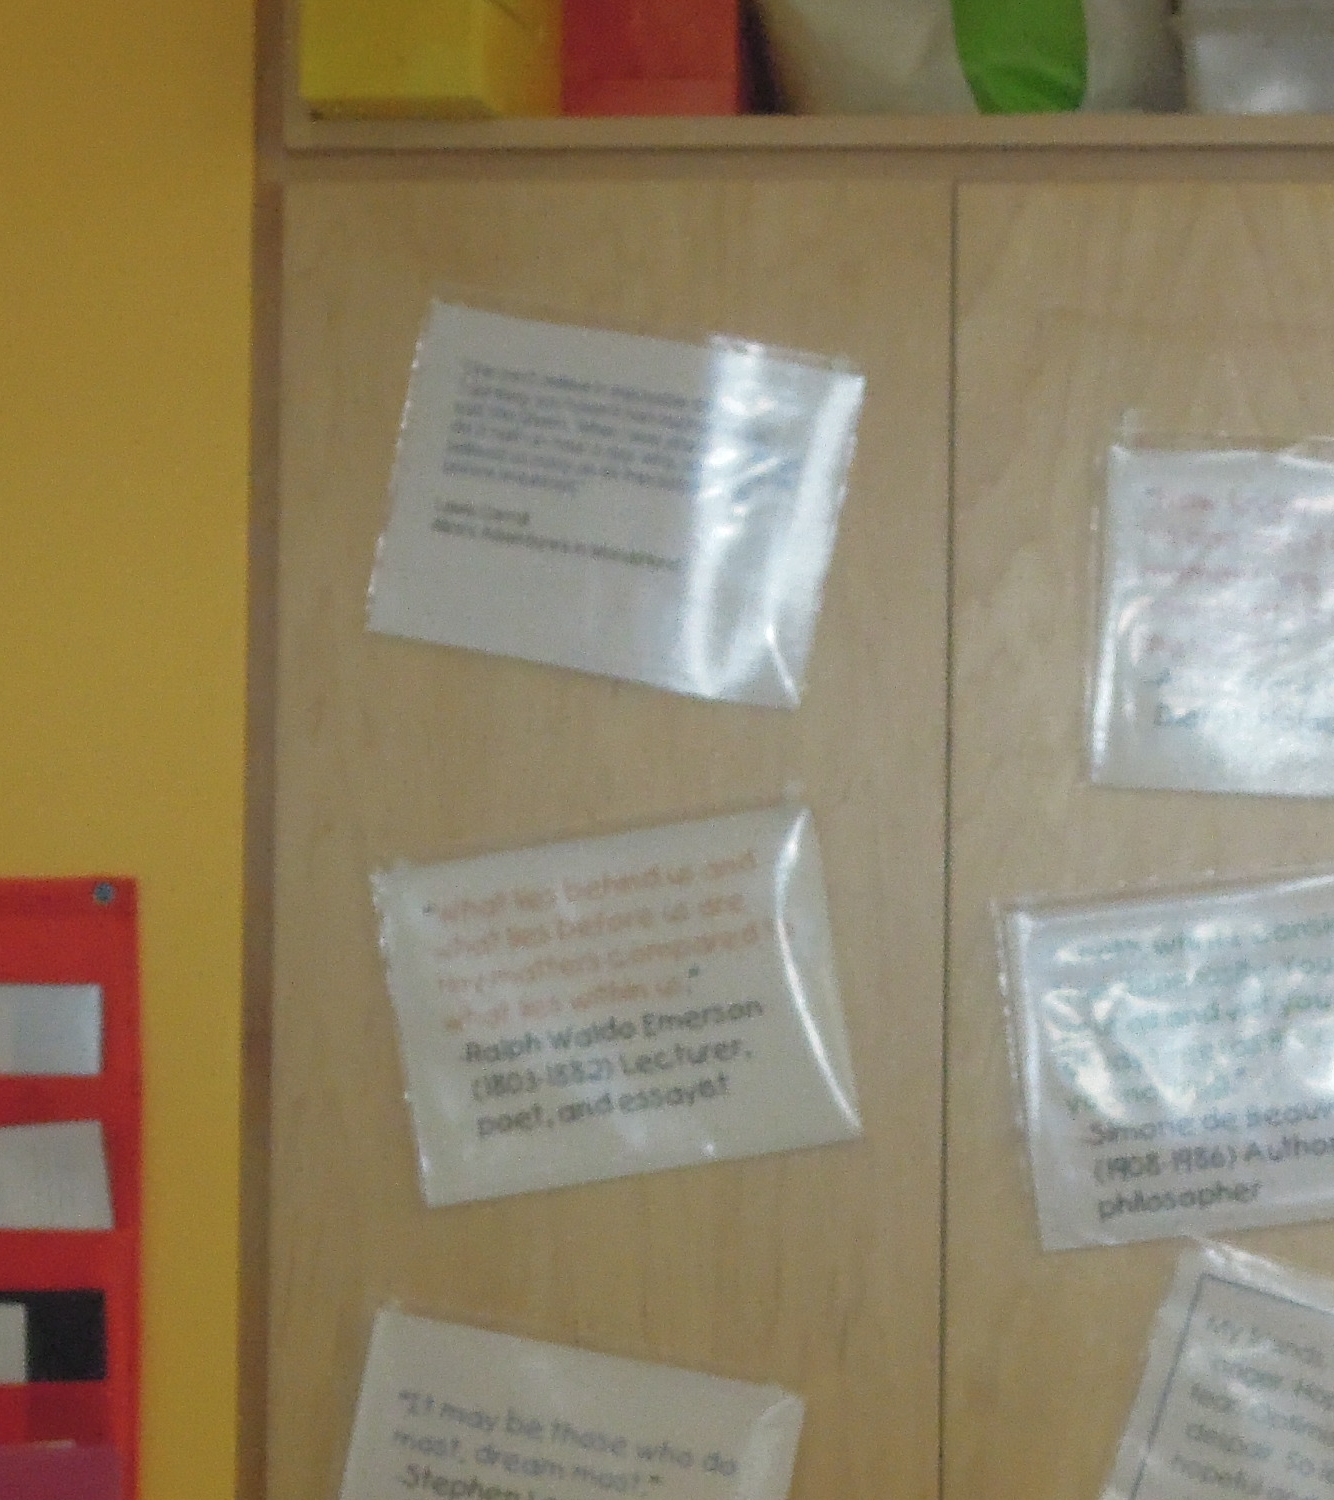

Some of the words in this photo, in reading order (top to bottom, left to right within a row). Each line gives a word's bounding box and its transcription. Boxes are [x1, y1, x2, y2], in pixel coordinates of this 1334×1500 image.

[562, 864, 659, 905] behind
[546, 1016, 637, 1053] Waldo
[640, 999, 766, 1039] Emerson
[618, 1037, 755, 1078] Lecturer,
[477, 1104, 555, 1140] poet,
[557, 1092, 615, 1126] and
[1096, 1180, 1264, 1222] philosopher
[439, 1399, 498, 1435] may
[506, 1406, 543, 1439] be
[552, 1418, 629, 1456] those
[635, 1441, 693, 1471] who
[701, 1449, 738, 1478] do
[473, 1442, 564, 1478] dream
